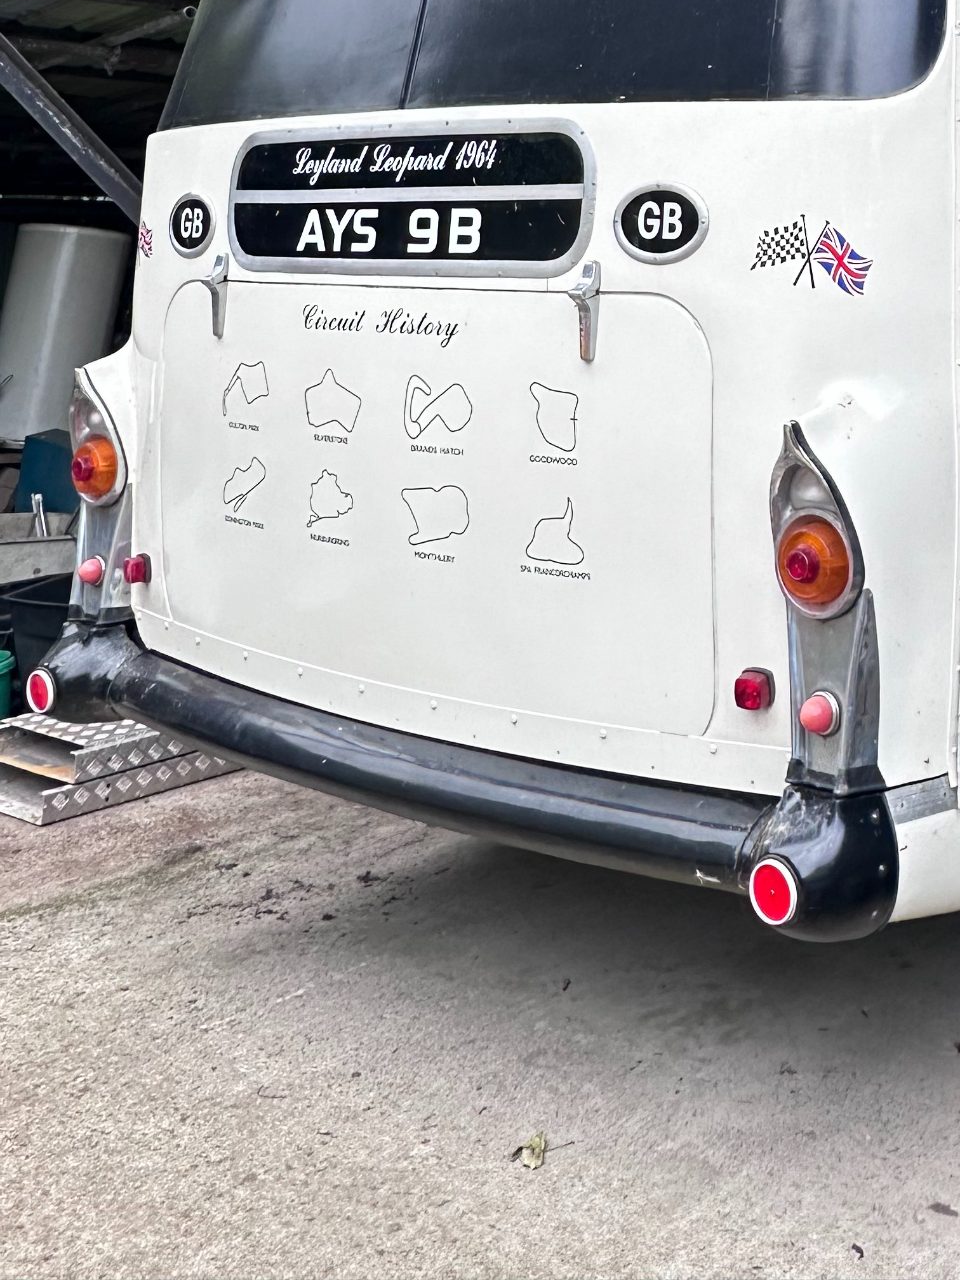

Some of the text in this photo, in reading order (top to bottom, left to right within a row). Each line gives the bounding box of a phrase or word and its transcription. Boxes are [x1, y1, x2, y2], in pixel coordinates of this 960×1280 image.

[292, 139, 499, 185] Leyland Leopard 1964
[180, 207, 204, 239] GB
[296, 208, 481, 254] AYS 9 B
[637, 201, 683, 240] GB
[302, 304, 460, 349] Circuit History
